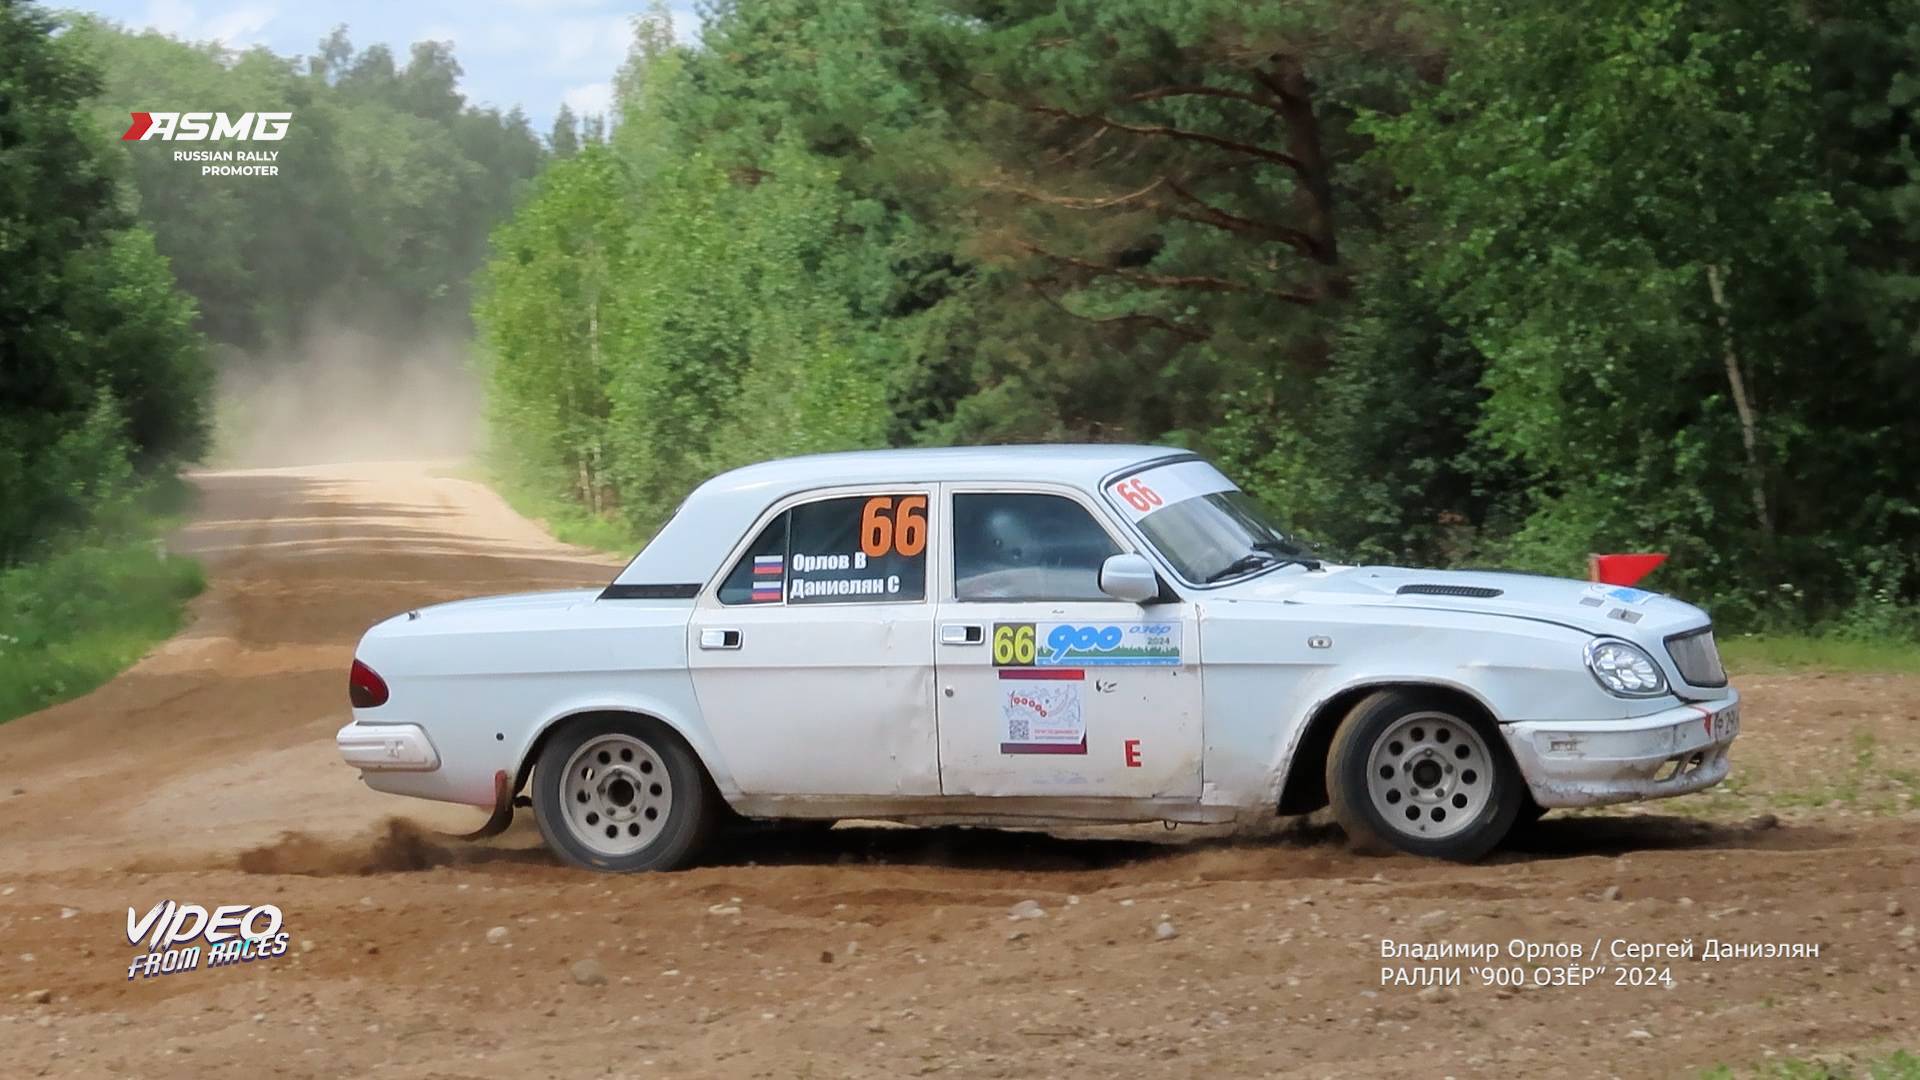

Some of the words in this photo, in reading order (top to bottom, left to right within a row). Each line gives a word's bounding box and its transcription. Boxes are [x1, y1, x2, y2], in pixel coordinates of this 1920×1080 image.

[1116, 478, 1163, 512] 66
[861, 496, 927, 557] 66
[793, 553, 850, 572] Орлов
[854, 552, 867, 569] В
[790, 578, 884, 599] Даниелян
[993, 626, 1034, 664] 66
[1048, 624, 1123, 663] 900
[1147, 637, 1170, 646] 2024
